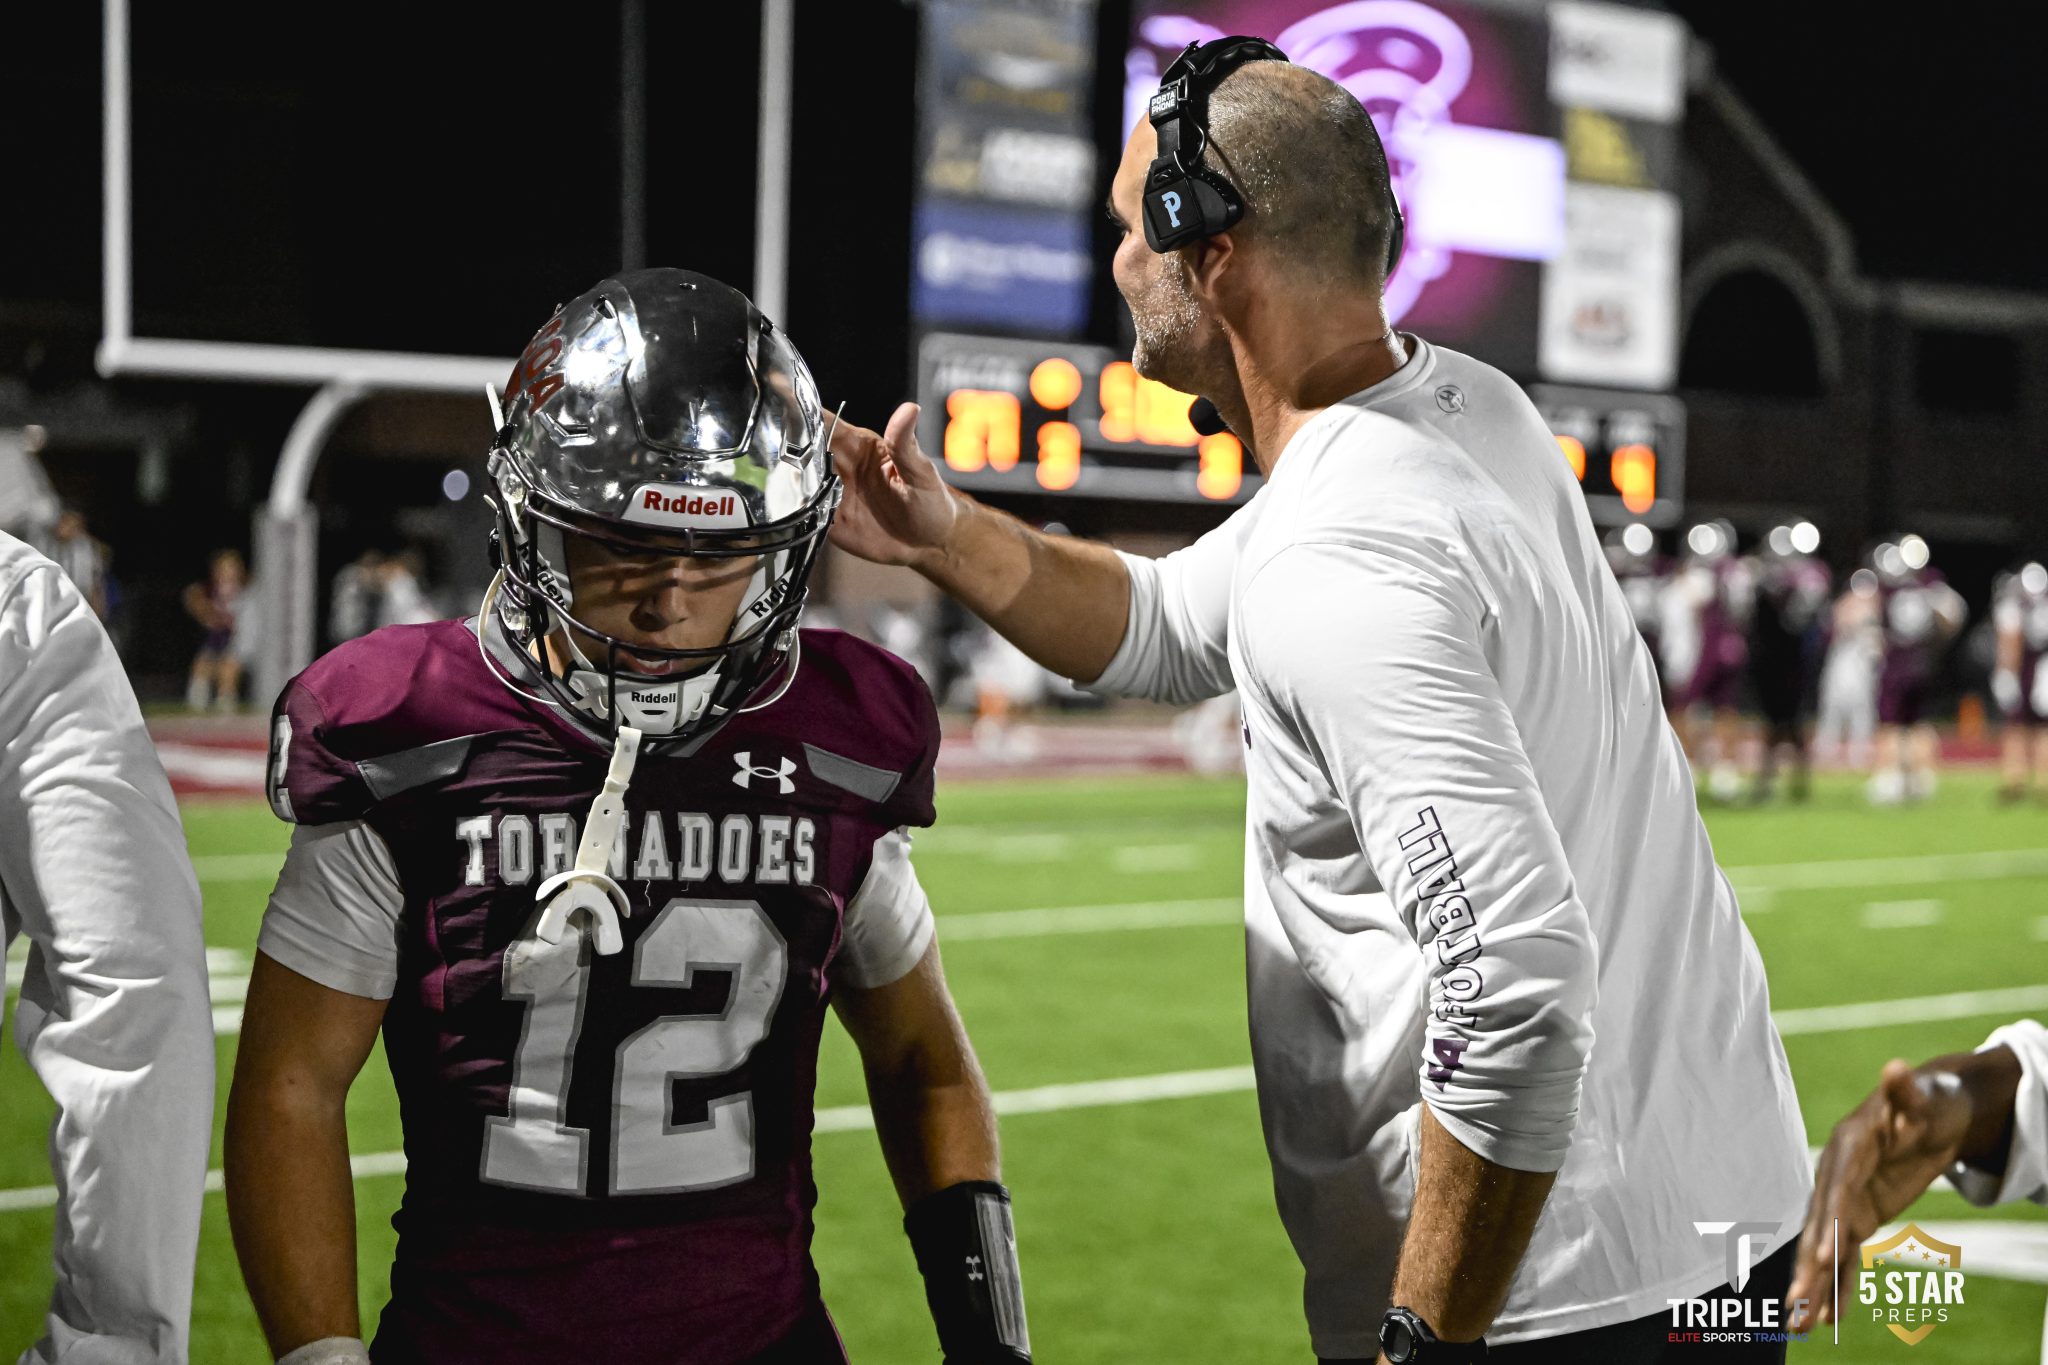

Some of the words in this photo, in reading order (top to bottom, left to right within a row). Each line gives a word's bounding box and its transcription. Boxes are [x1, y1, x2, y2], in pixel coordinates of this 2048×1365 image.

[1151, 89, 1176, 106] PORTA
[1151, 100, 1176, 115] PHONE
[1161, 190, 1182, 228] P
[643, 489, 735, 516] Riddell
[749, 577, 791, 619] Ridd
[631, 691, 677, 704] Riddell
[479, 898, 788, 1198] 12
